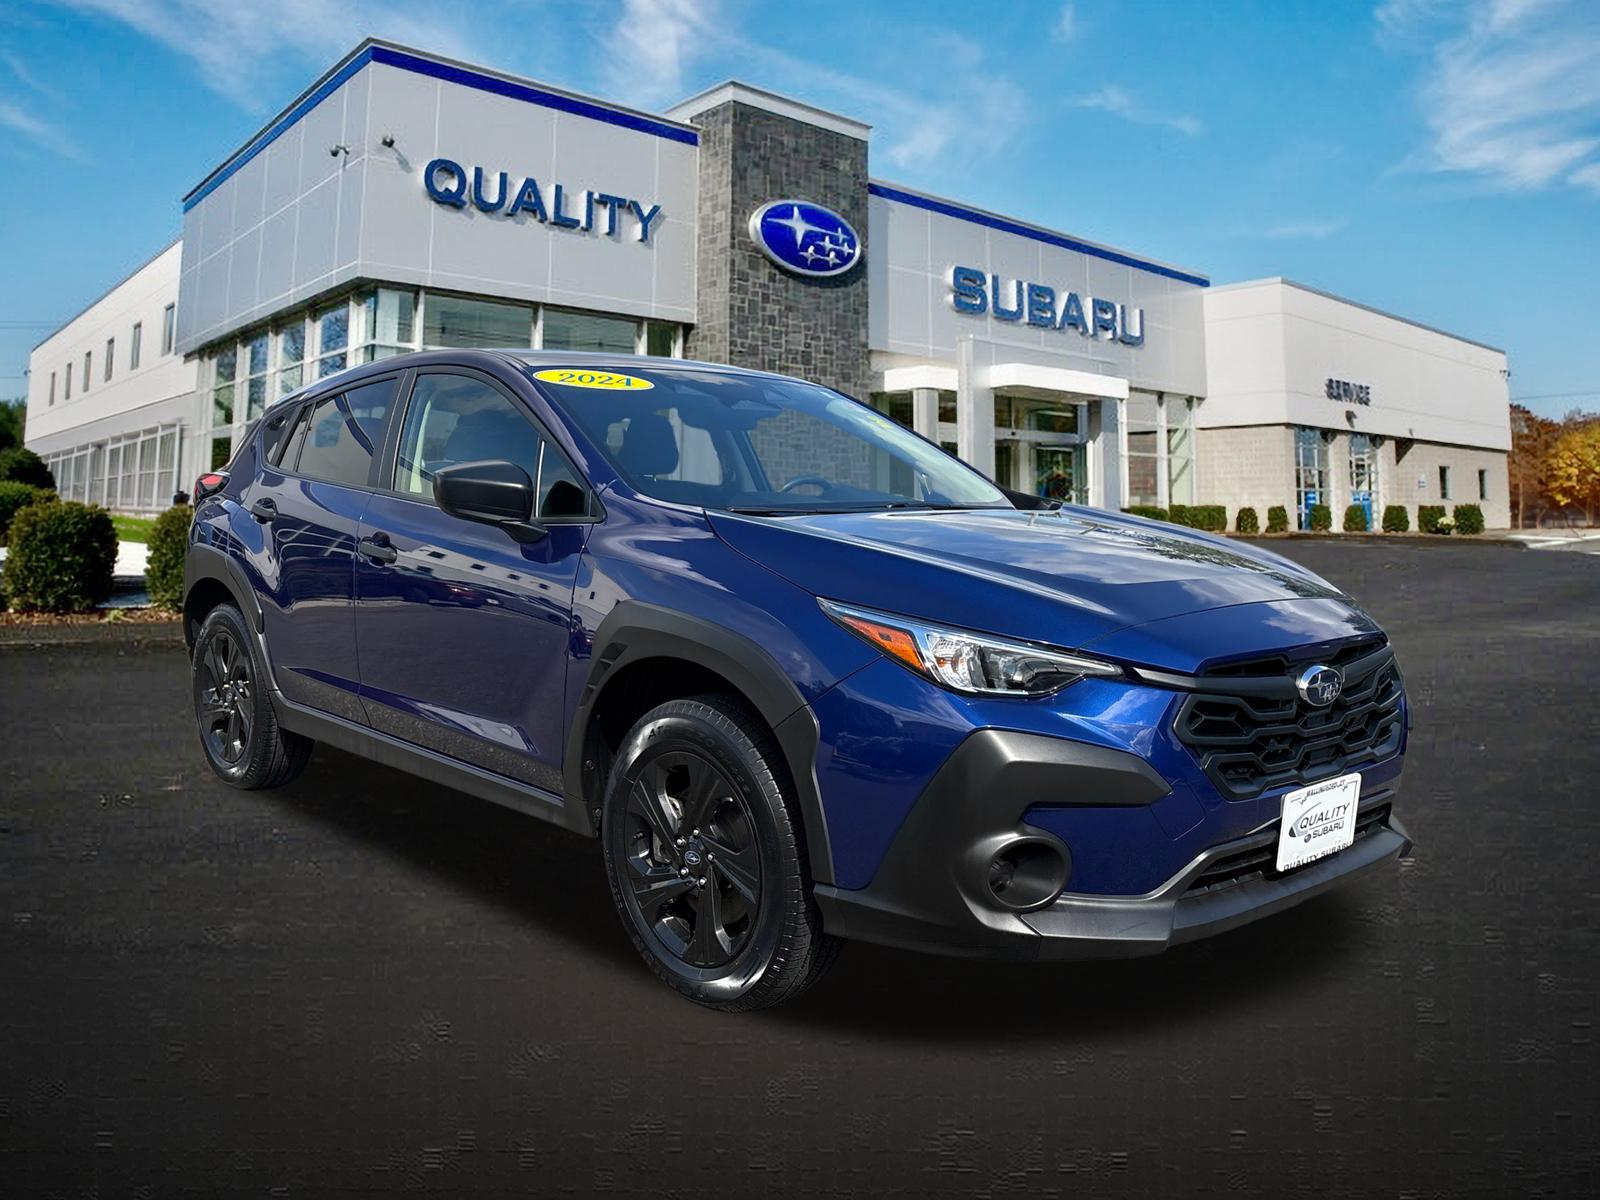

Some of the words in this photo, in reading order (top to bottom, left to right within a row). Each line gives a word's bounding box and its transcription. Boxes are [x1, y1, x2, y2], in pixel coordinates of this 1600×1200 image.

[423, 157, 662, 242] QUALITY
[949, 265, 1145, 347] SUBARU
[559, 372, 635, 387] 2024
[1300, 802, 1351, 829] QUALITY
[1312, 821, 1345, 839] SUBARU
